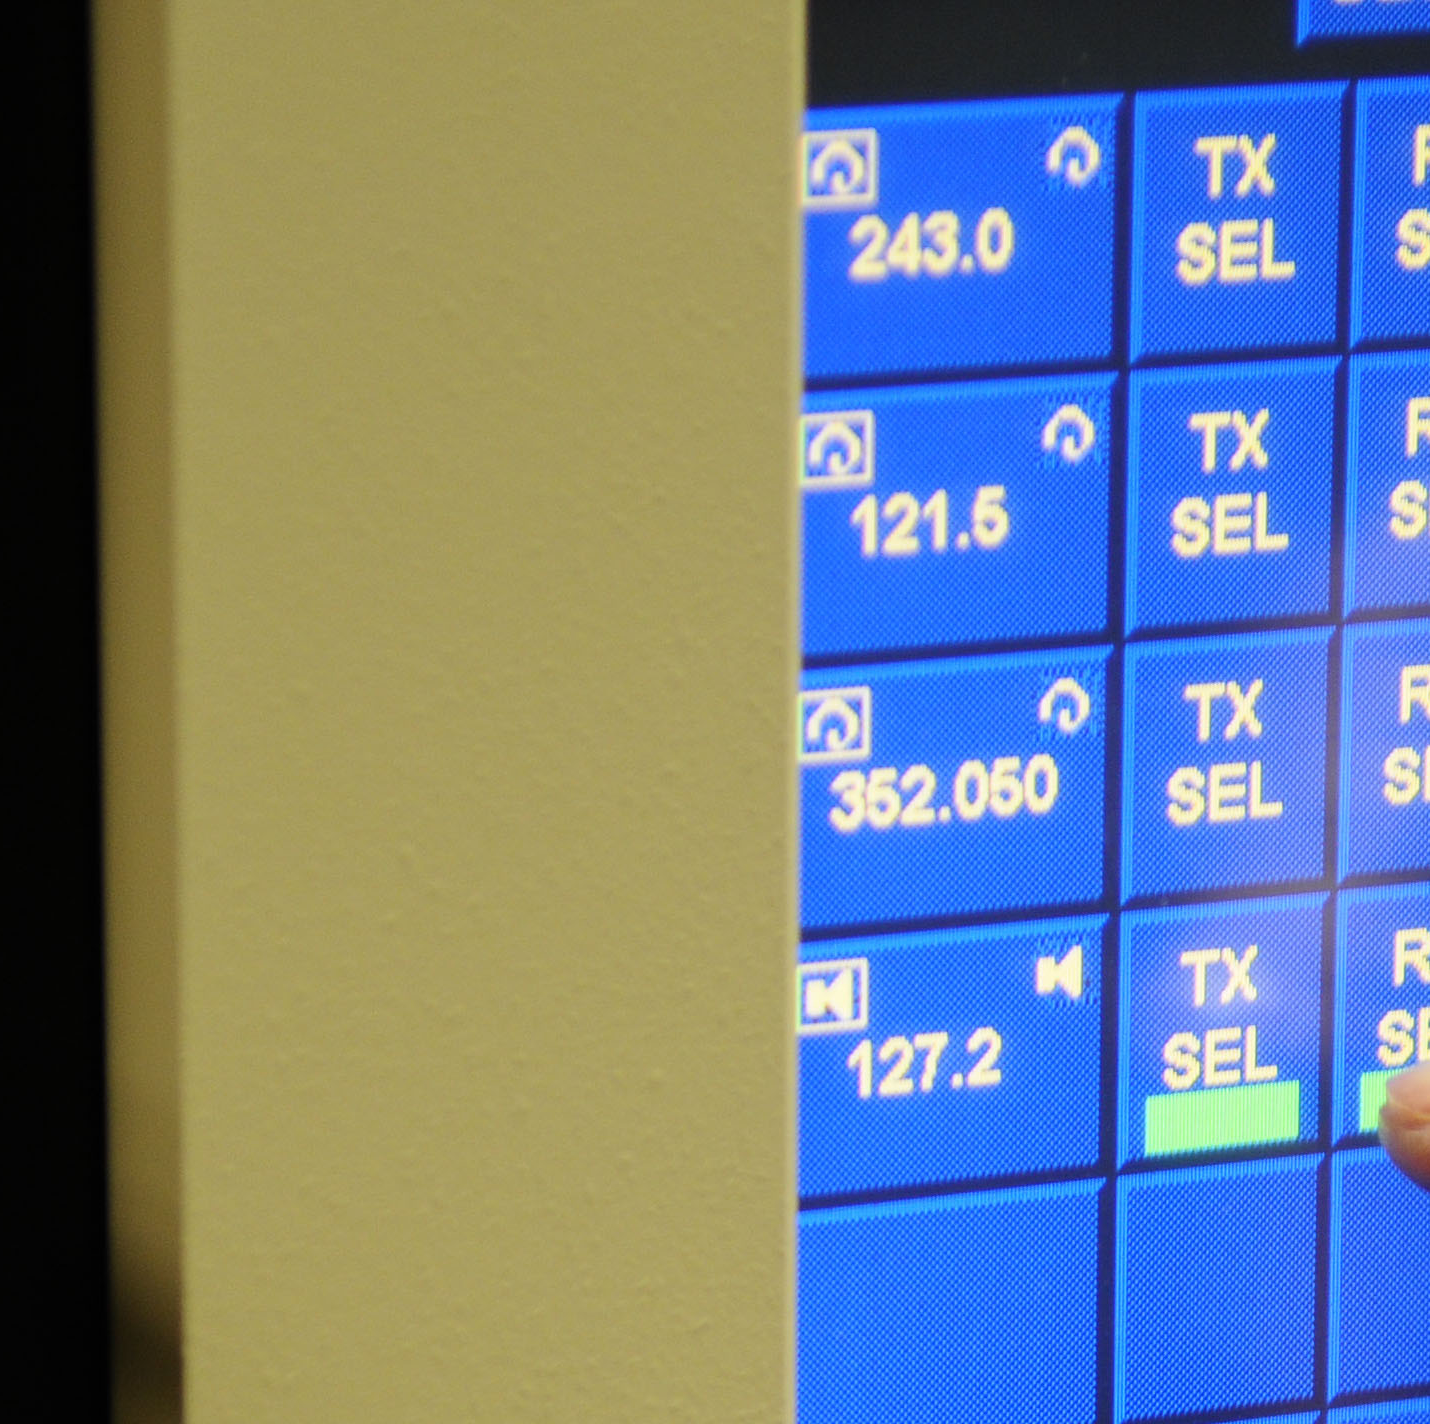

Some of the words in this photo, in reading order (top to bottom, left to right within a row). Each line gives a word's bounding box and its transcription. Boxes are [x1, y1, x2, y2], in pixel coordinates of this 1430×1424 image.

[1193, 132, 1277, 199] TX
[848, 206, 1016, 282] 243.0
[1175, 217, 1297, 286] SEL
[1188, 407, 1271, 474] TX
[850, 484, 1011, 557] 121.5
[1170, 490, 1290, 559] SEL
[1182, 677, 1265, 743] TX
[828, 752, 1060, 834] 352.050
[1165, 759, 1285, 828] SEL
[1178, 942, 1261, 1010] TX
[846, 1025, 1003, 1099] 127.2
[1163, 1025, 1278, 1090] SEL
